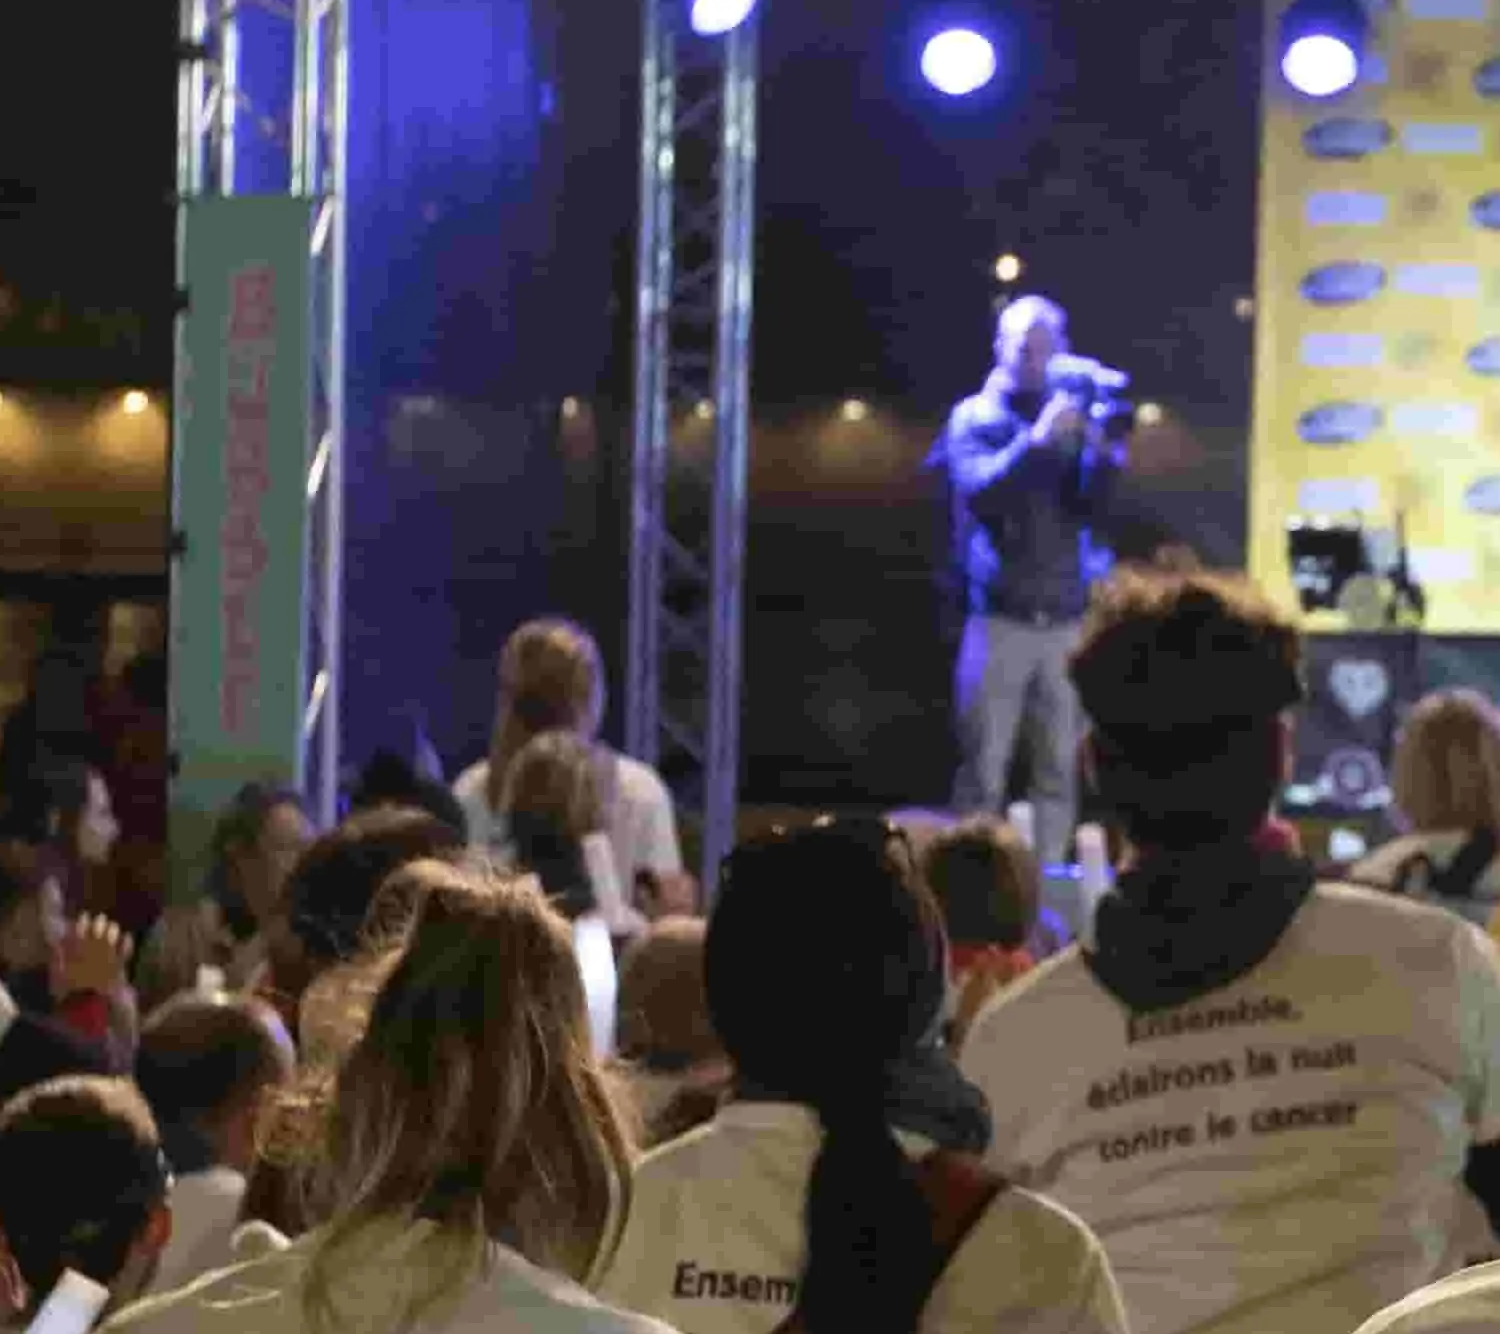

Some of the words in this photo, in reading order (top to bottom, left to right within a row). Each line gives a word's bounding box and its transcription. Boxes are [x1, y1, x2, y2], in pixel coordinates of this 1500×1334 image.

[1087, 1055, 1238, 1110] éclairons
[1245, 1042, 1278, 1076] la
[1290, 1038, 1358, 1073] nuit
[1097, 1122, 1197, 1165] contre
[1206, 1108, 1236, 1141] le
[1251, 1099, 1358, 1137] cancer
[671, 1259, 796, 1306] Ensem
